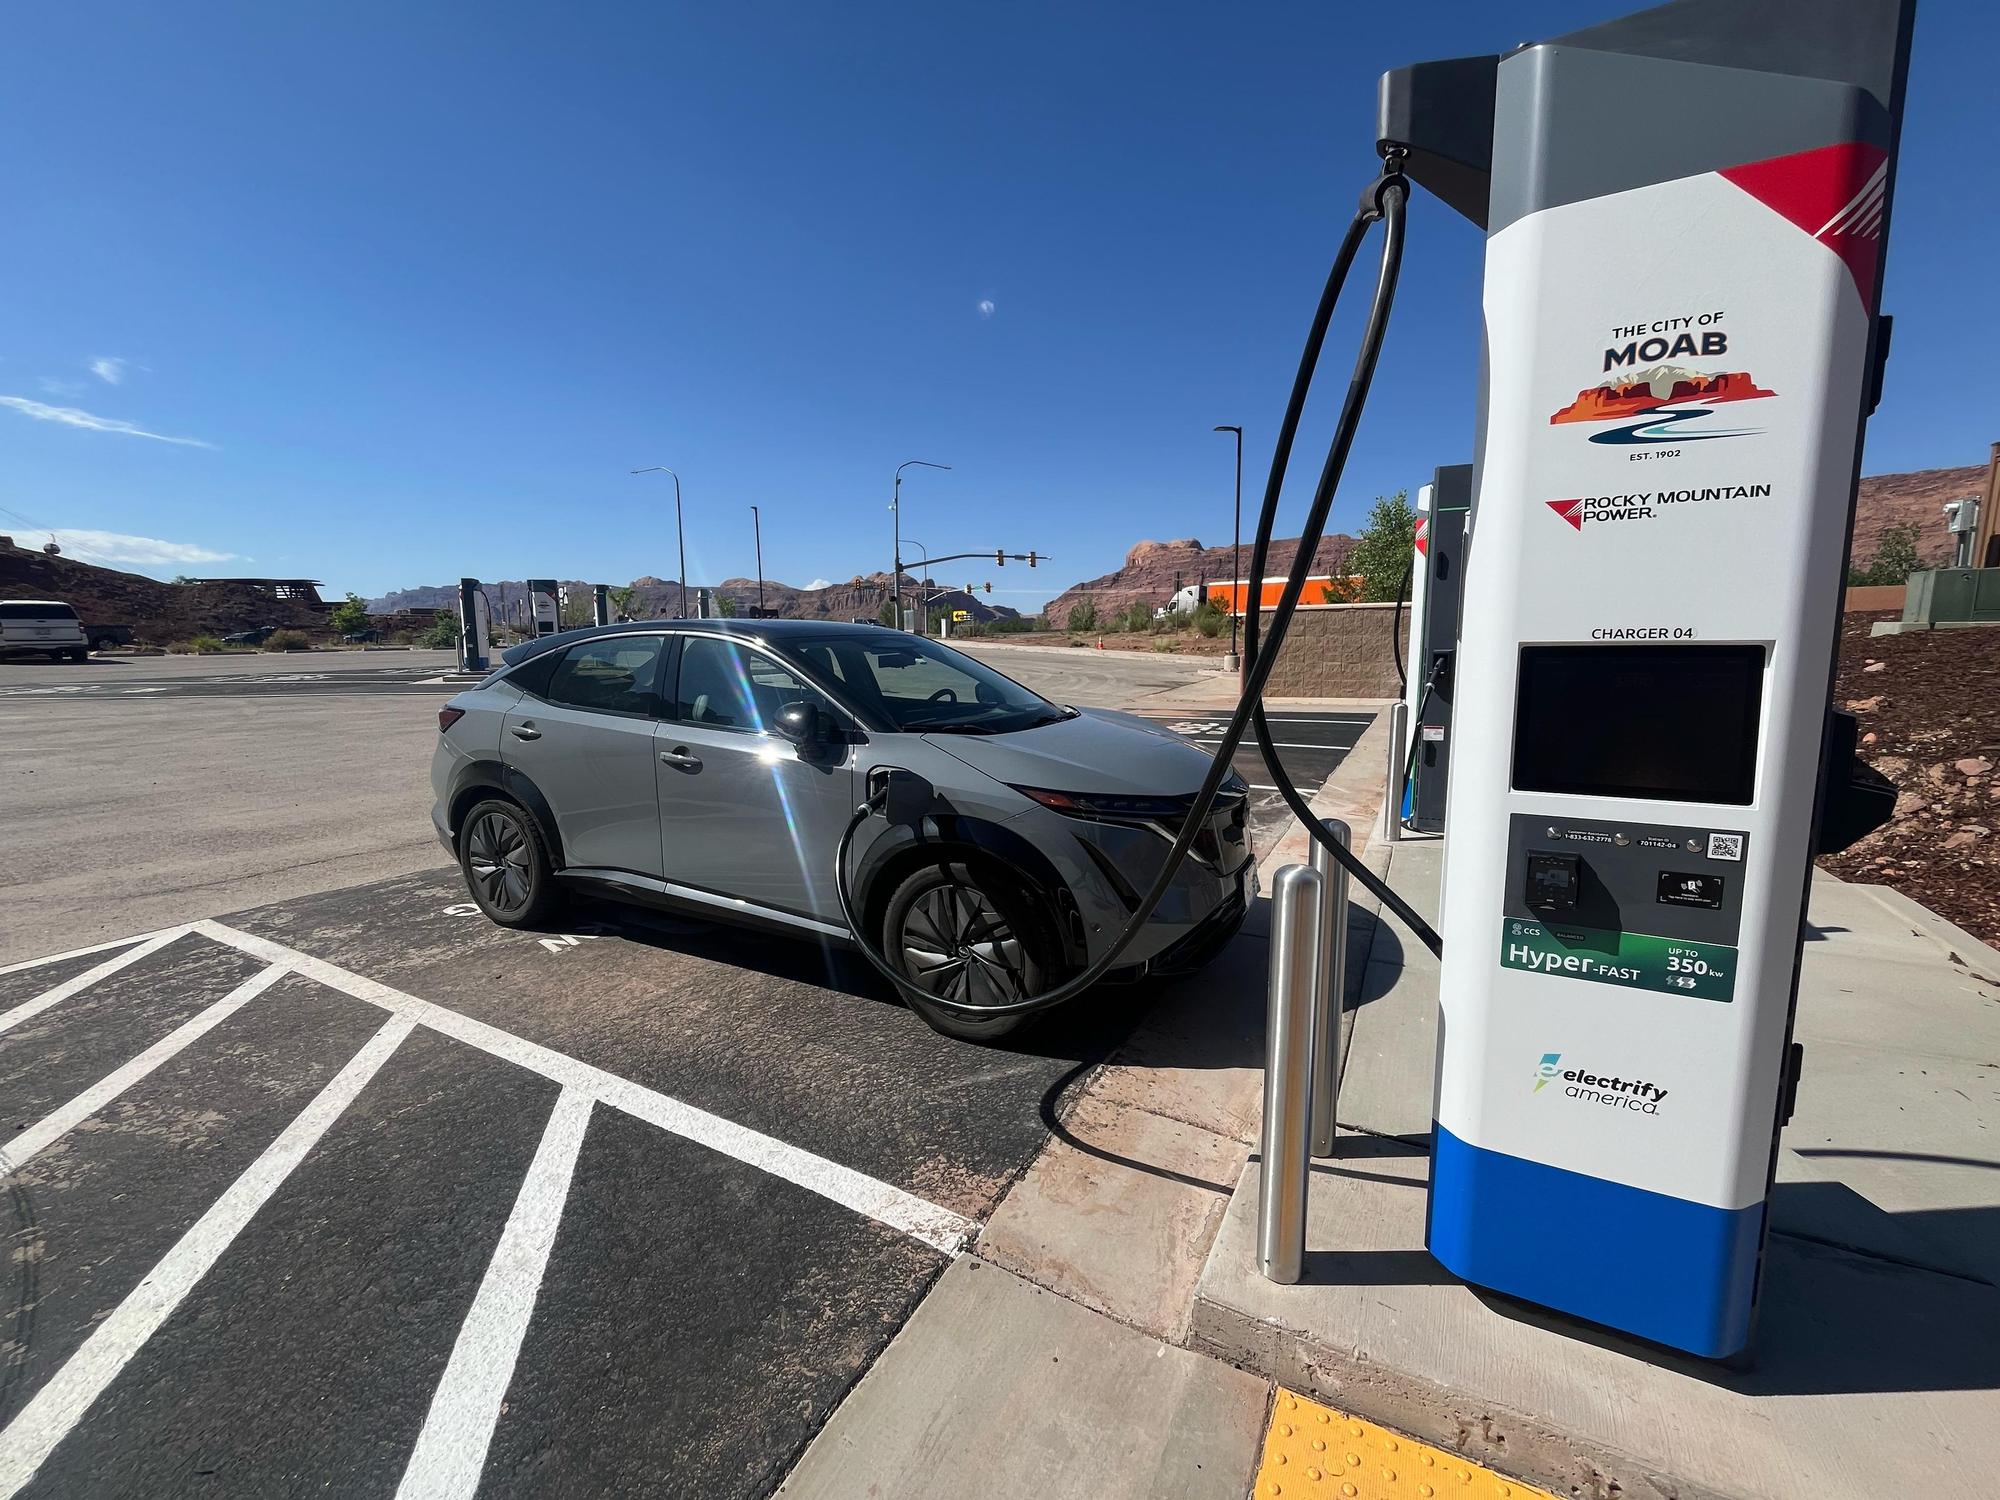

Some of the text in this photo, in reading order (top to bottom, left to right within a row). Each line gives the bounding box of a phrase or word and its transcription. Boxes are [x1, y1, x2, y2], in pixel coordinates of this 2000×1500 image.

[1612, 311, 1724, 339] THE CITY OF
[1603, 331, 1728, 373] MOAB
[1629, 450, 1681, 461] EST. 1902
[1583, 484, 1771, 510] ROCKY MOUNTAIN
[1591, 627, 1693, 640] CHARGER 04
[1565, 833, 1612, 843] 1-833-632-2778
[1640, 840, 1677, 849] 701142-04
[1523, 927, 1541, 936] CCS
[1668, 947, 1698, 958] UP TO
[1666, 956, 1708, 975] 350
[1563, 1069, 1668, 1103] electrify
